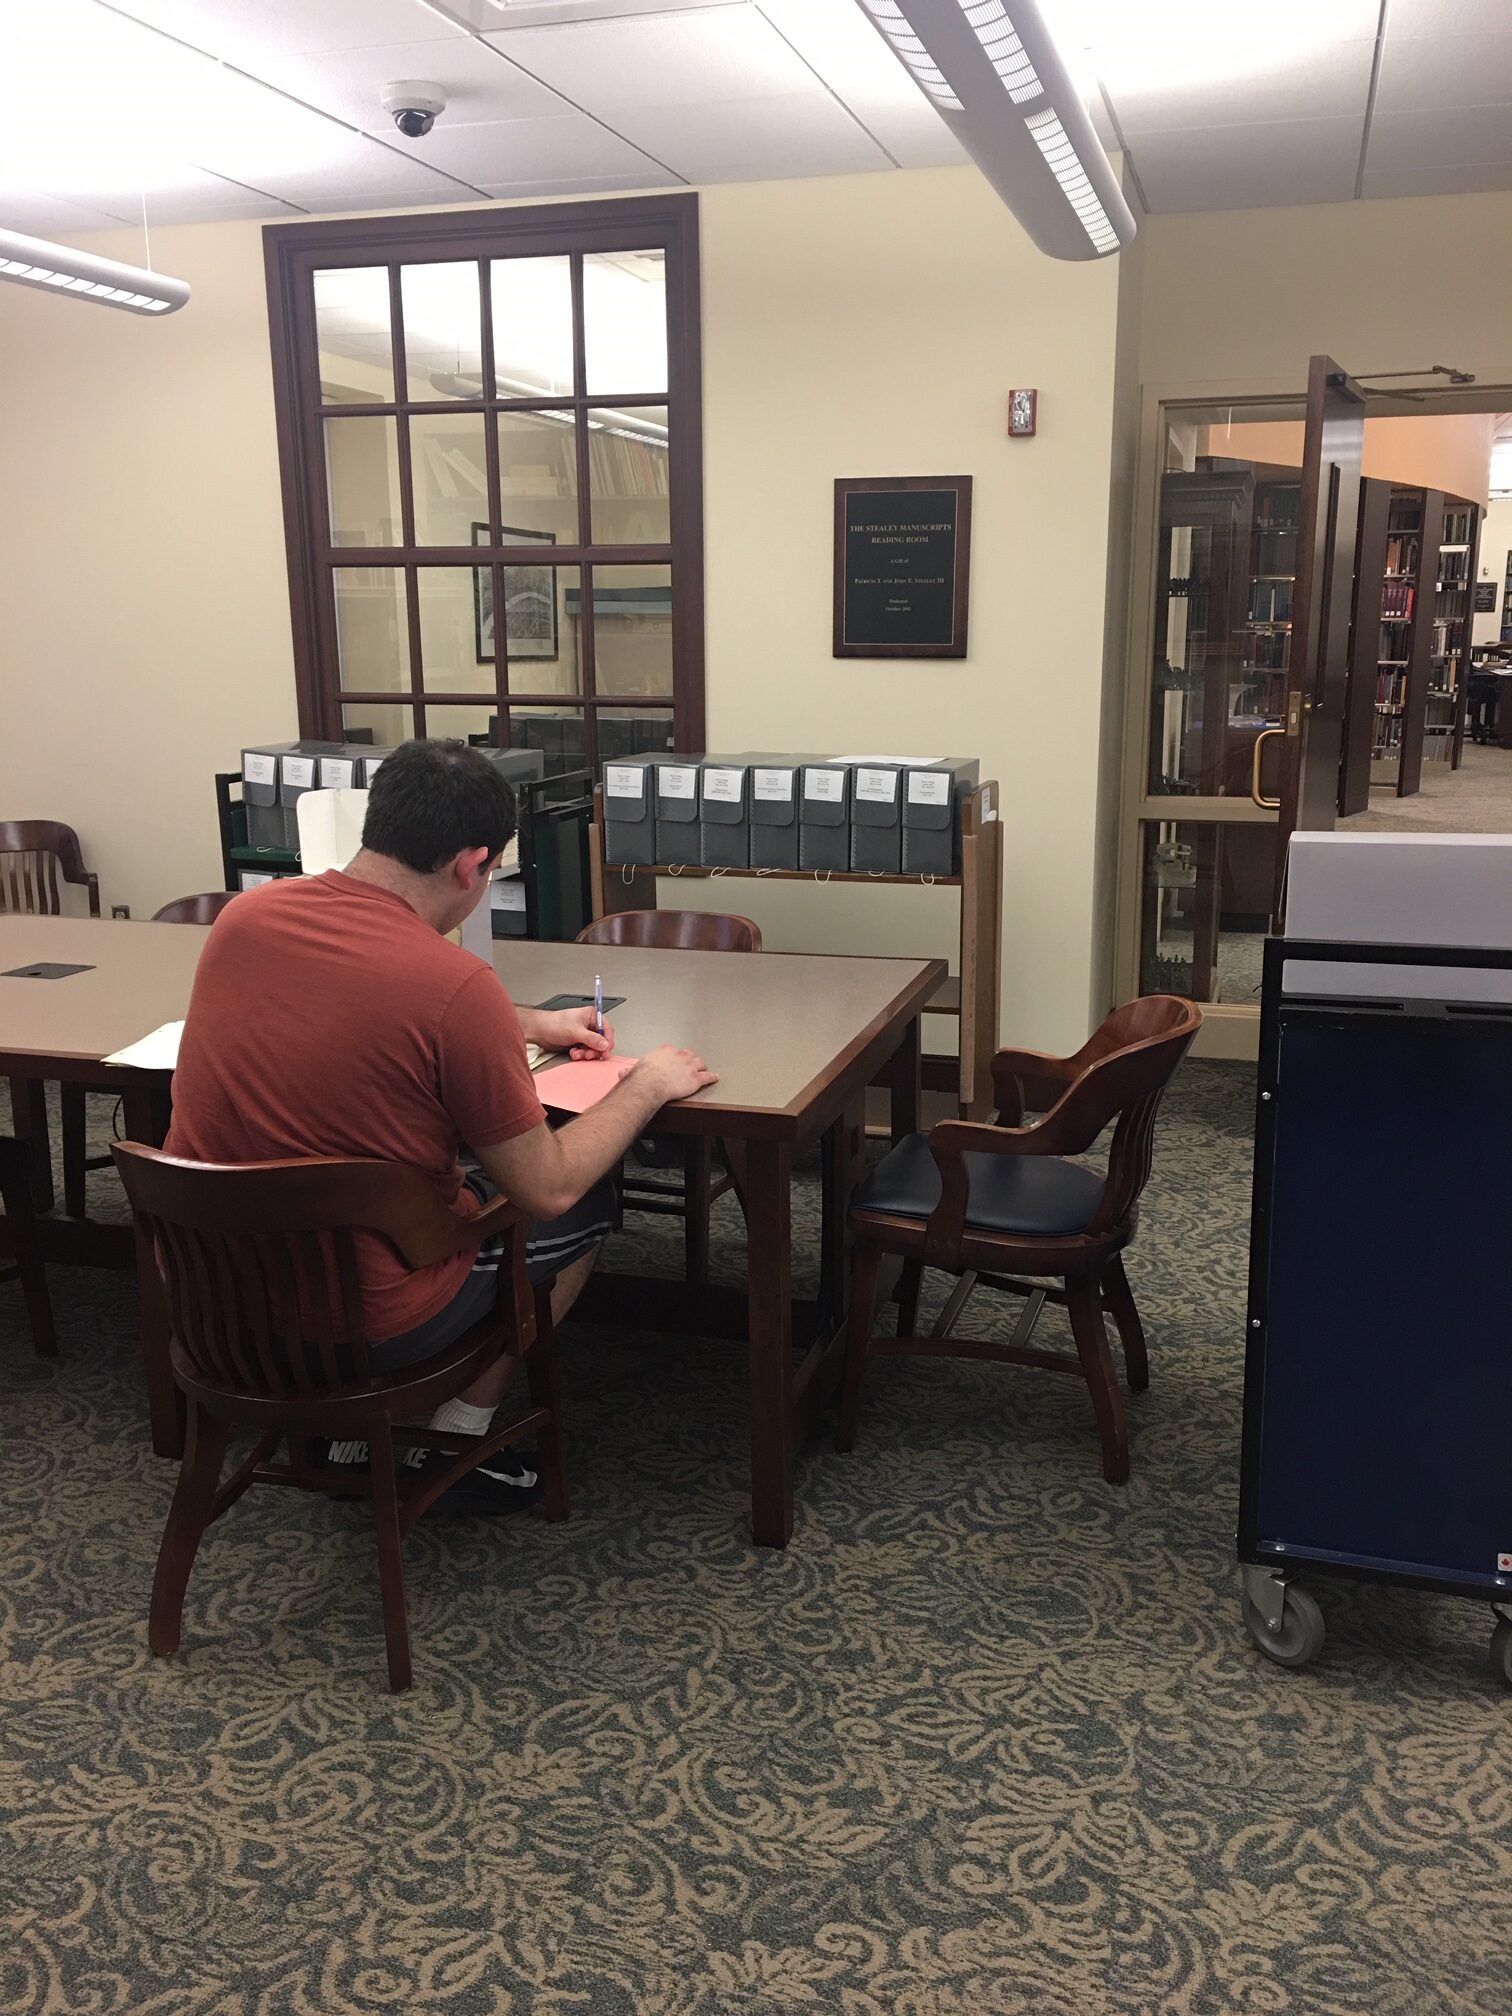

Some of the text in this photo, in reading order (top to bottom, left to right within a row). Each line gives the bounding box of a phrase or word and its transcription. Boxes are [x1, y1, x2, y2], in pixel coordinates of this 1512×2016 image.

[866, 524, 898, 532] STEALEY
[937, 576, 945, 584] III
[327, 1440, 369, 1464] NIKE
